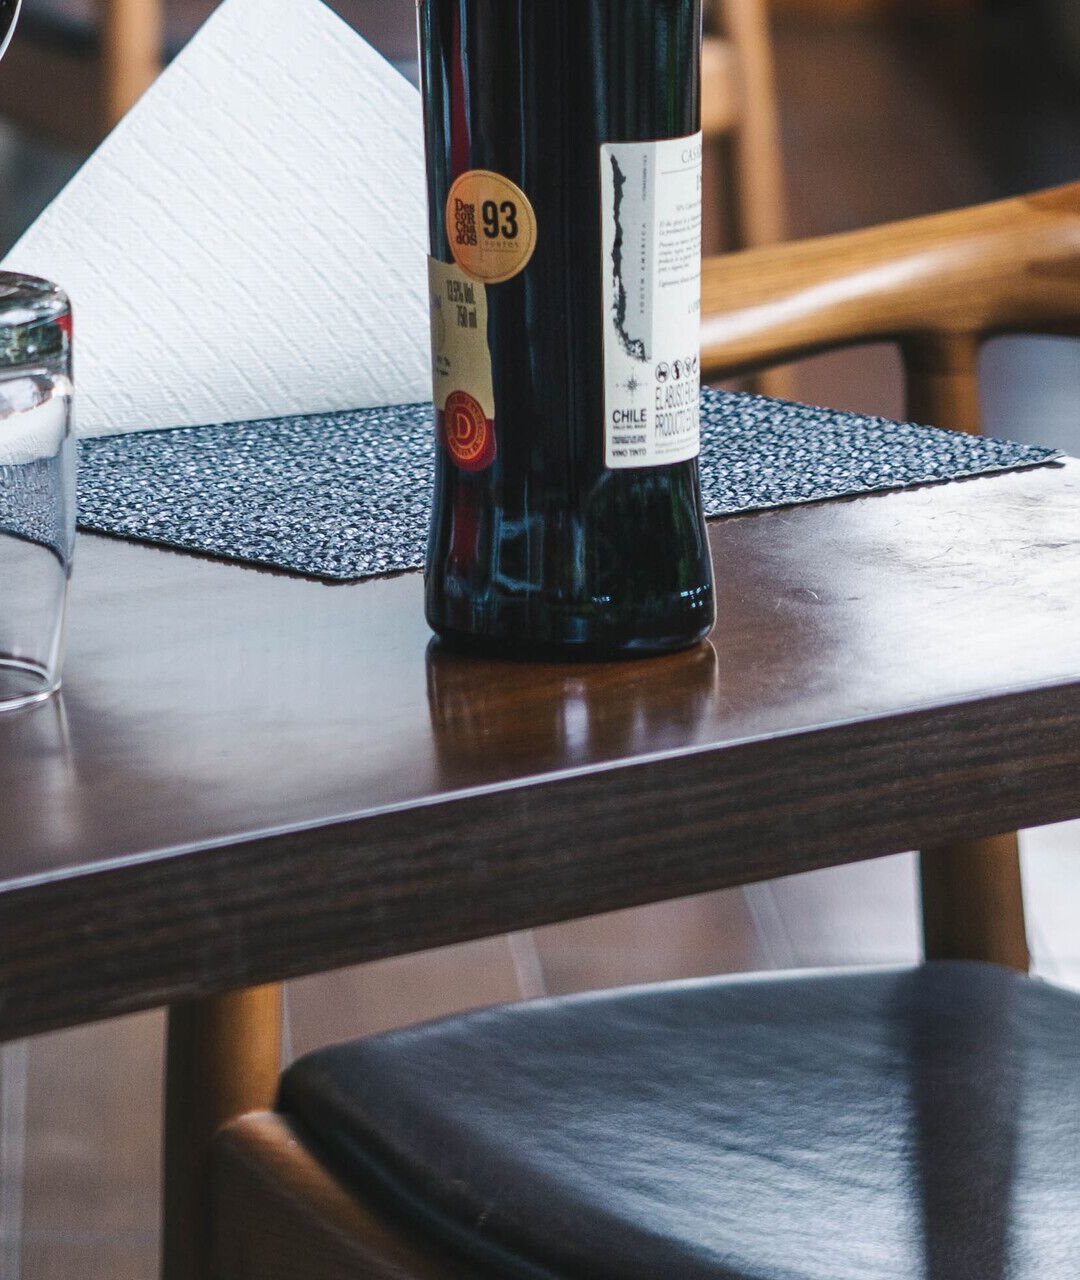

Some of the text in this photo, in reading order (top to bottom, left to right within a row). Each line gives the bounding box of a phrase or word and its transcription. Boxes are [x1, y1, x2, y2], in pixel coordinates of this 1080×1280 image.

[482, 200, 518, 239] 93
[456, 413, 471, 438] D
[612, 408, 647, 424] CHILE
[612, 448, 628, 457] VINO
[629, 447, 647, 456] TINTO
